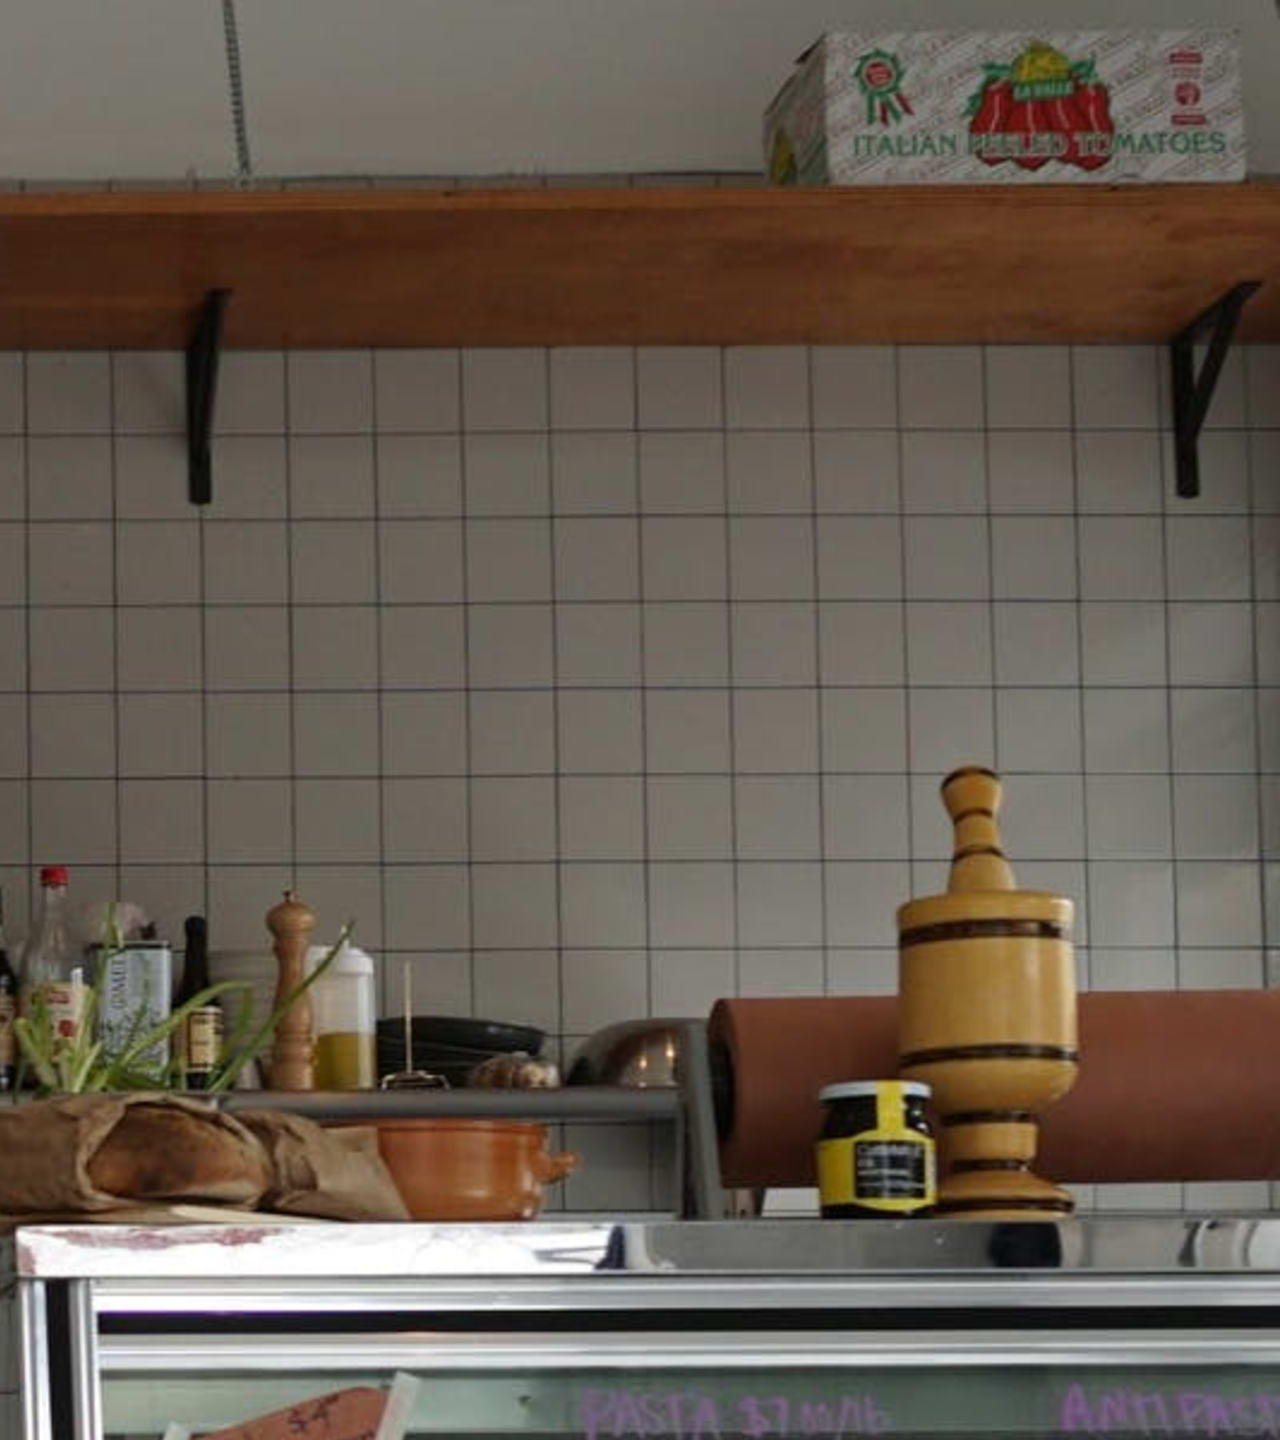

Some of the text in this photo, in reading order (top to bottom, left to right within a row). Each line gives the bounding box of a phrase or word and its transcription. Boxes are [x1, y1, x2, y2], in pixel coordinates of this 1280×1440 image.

[854, 130, 1227, 158] ITALIAN PEELED TOMATOES
